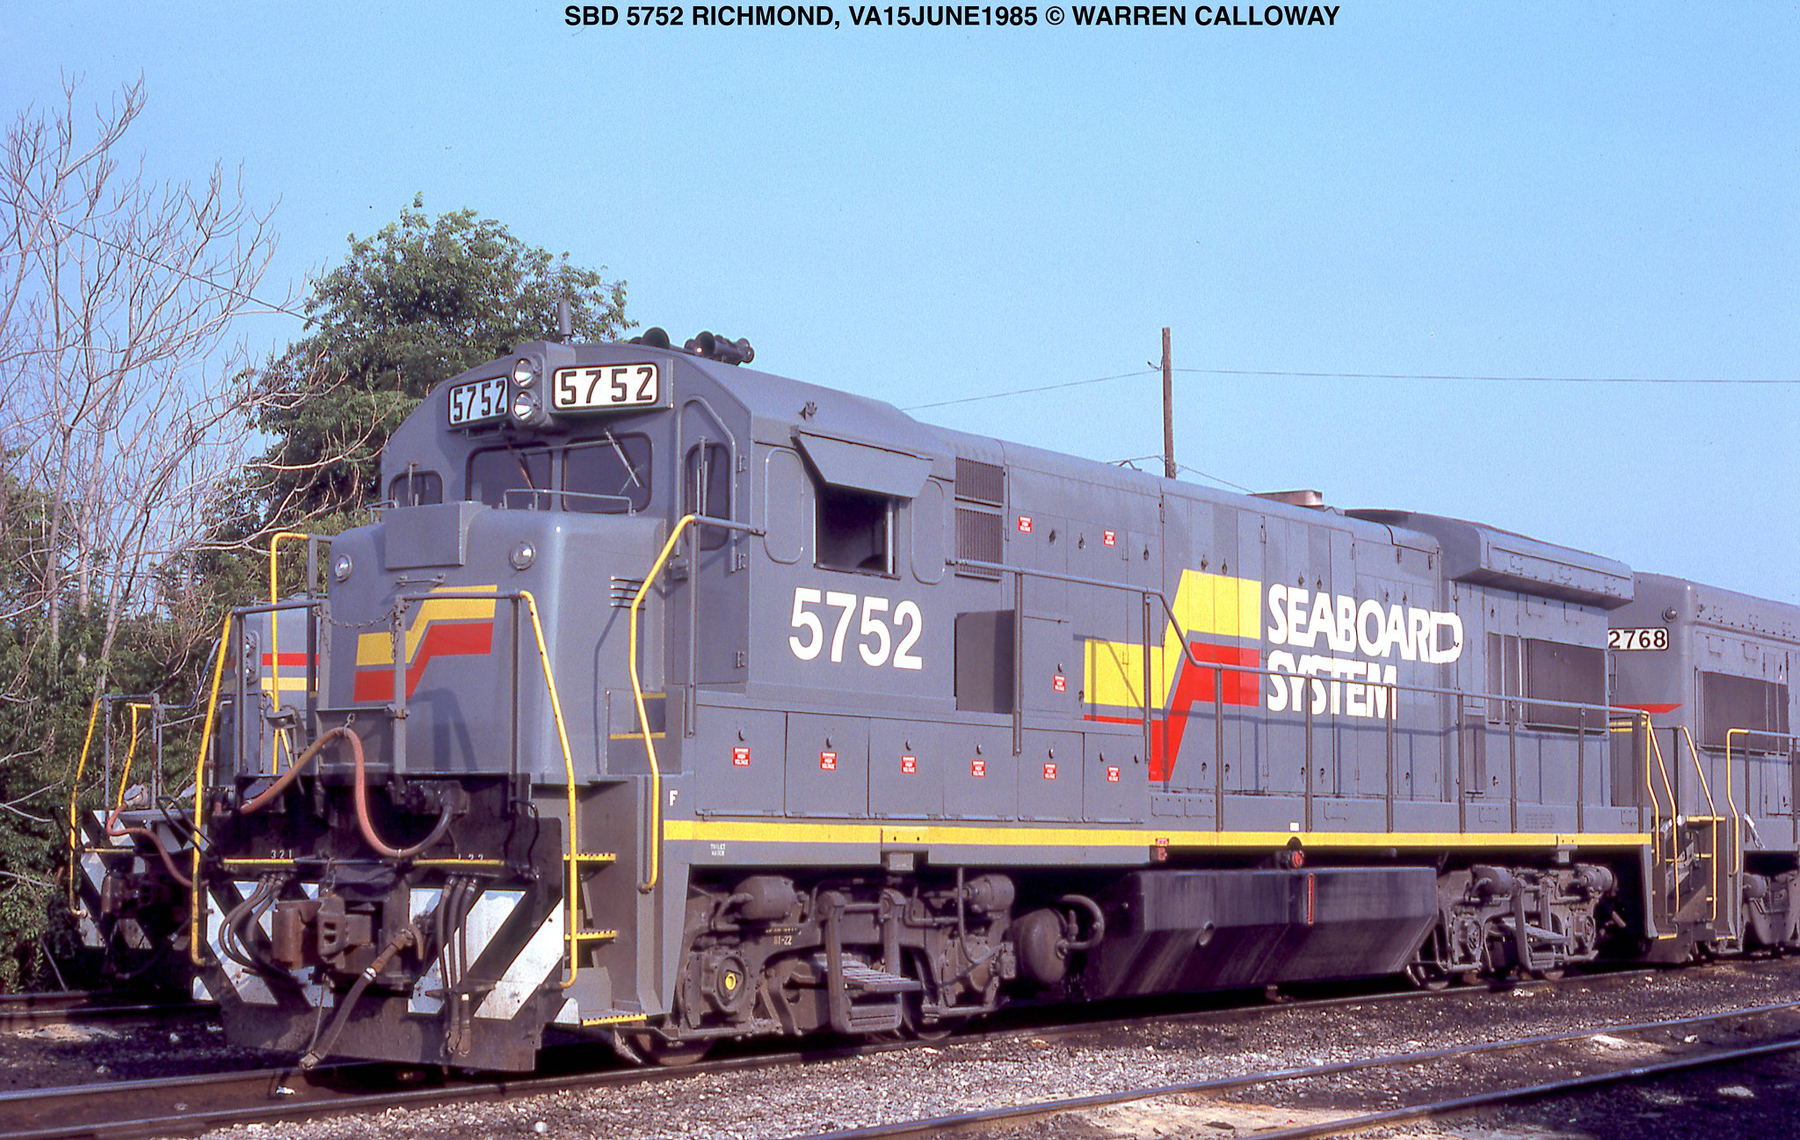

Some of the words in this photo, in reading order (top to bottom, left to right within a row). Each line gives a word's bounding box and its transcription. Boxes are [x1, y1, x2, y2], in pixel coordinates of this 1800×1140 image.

[453, 379, 506, 421] 5752
[560, 366, 654, 405] 5752
[788, 586, 923, 670] 5752
[1267, 583, 1464, 664] SEABOARD
[1608, 630, 1666, 649] 2768
[1266, 649, 1397, 720] SYSTEM
[669, 790, 679, 806] F
